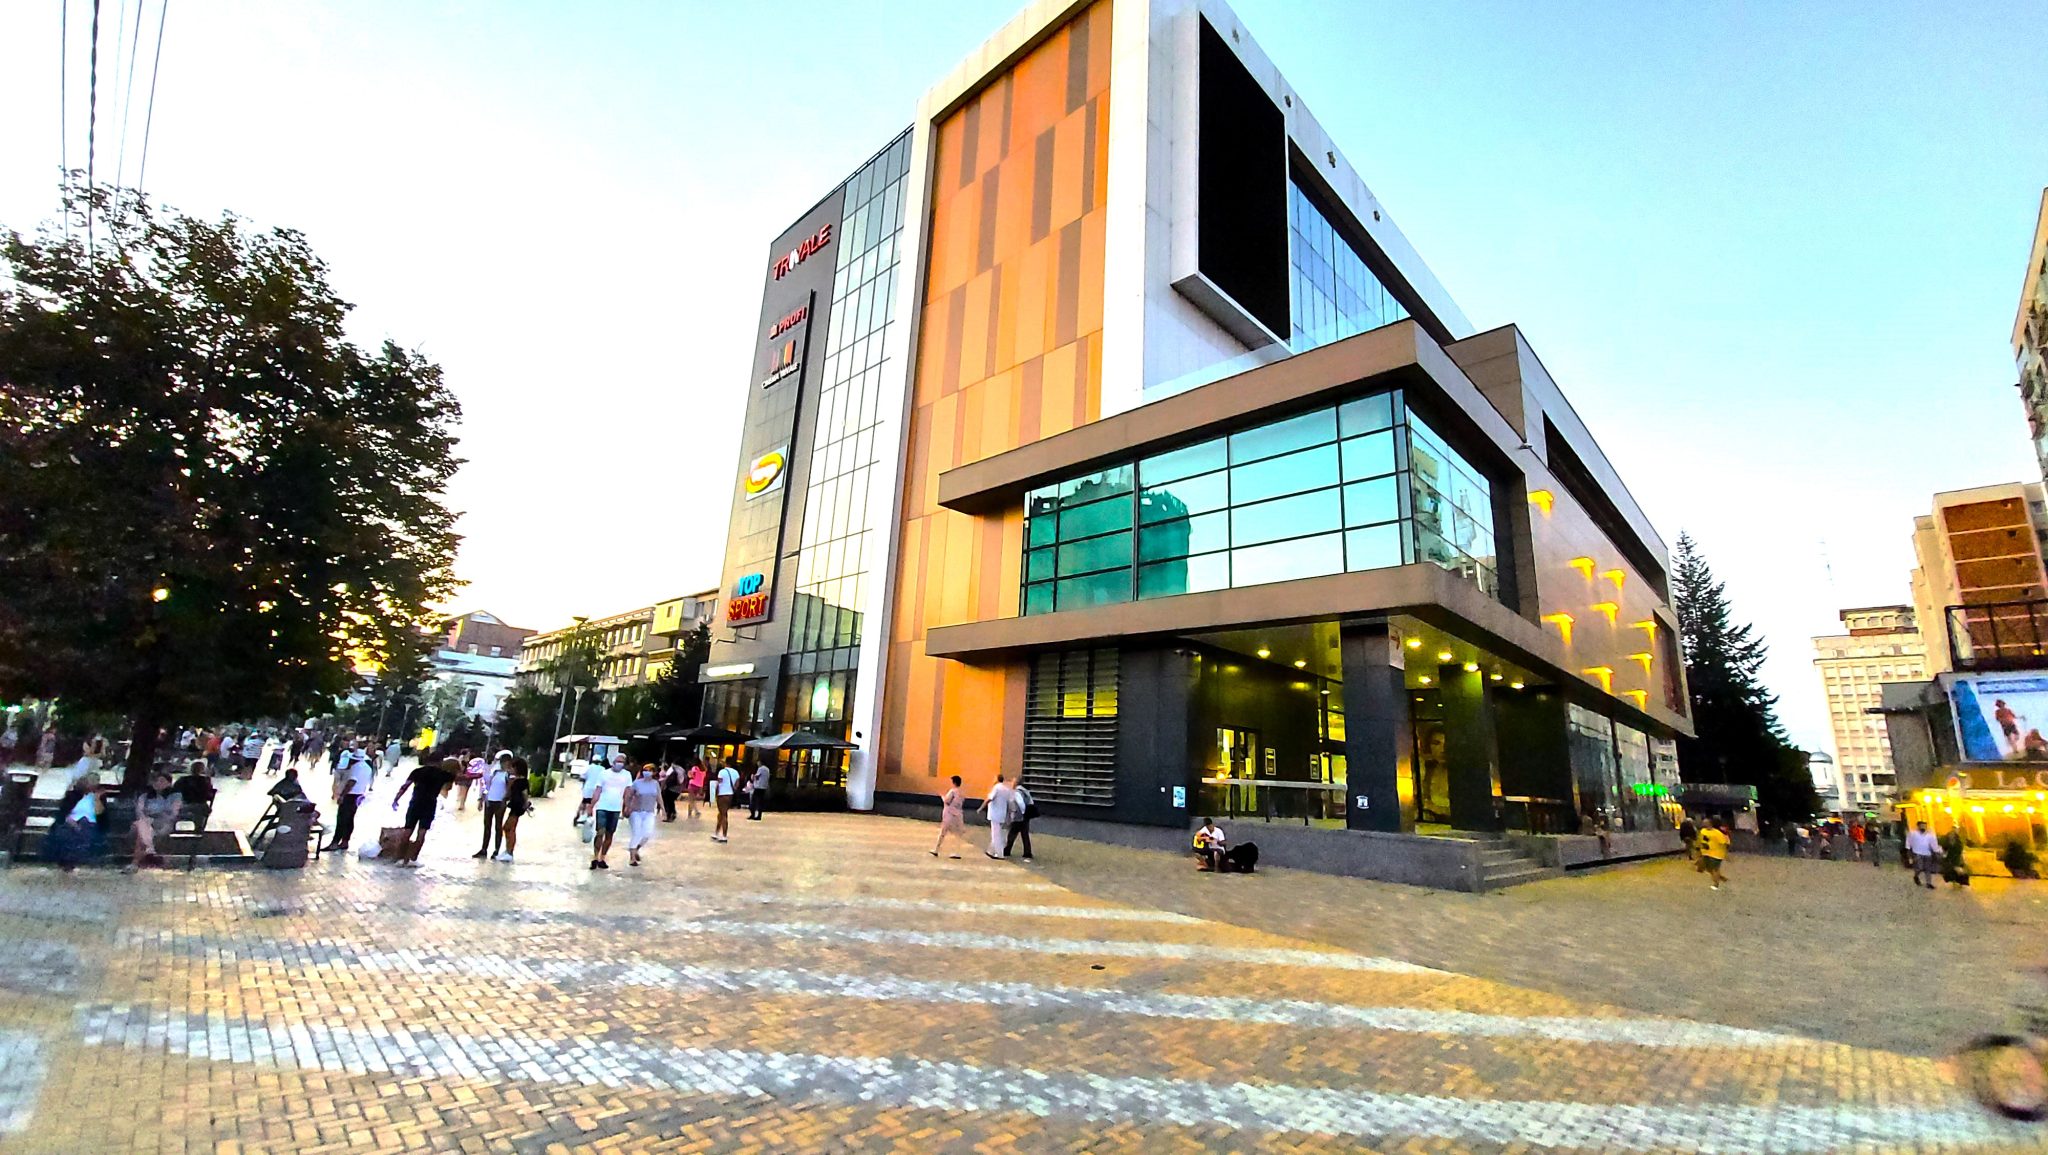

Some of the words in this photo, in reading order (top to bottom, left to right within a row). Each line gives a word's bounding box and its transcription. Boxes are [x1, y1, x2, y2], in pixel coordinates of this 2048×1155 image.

[779, 306, 807, 333] PROFI
[738, 573, 764, 596] TOP
[727, 595, 768, 620] SPORT
